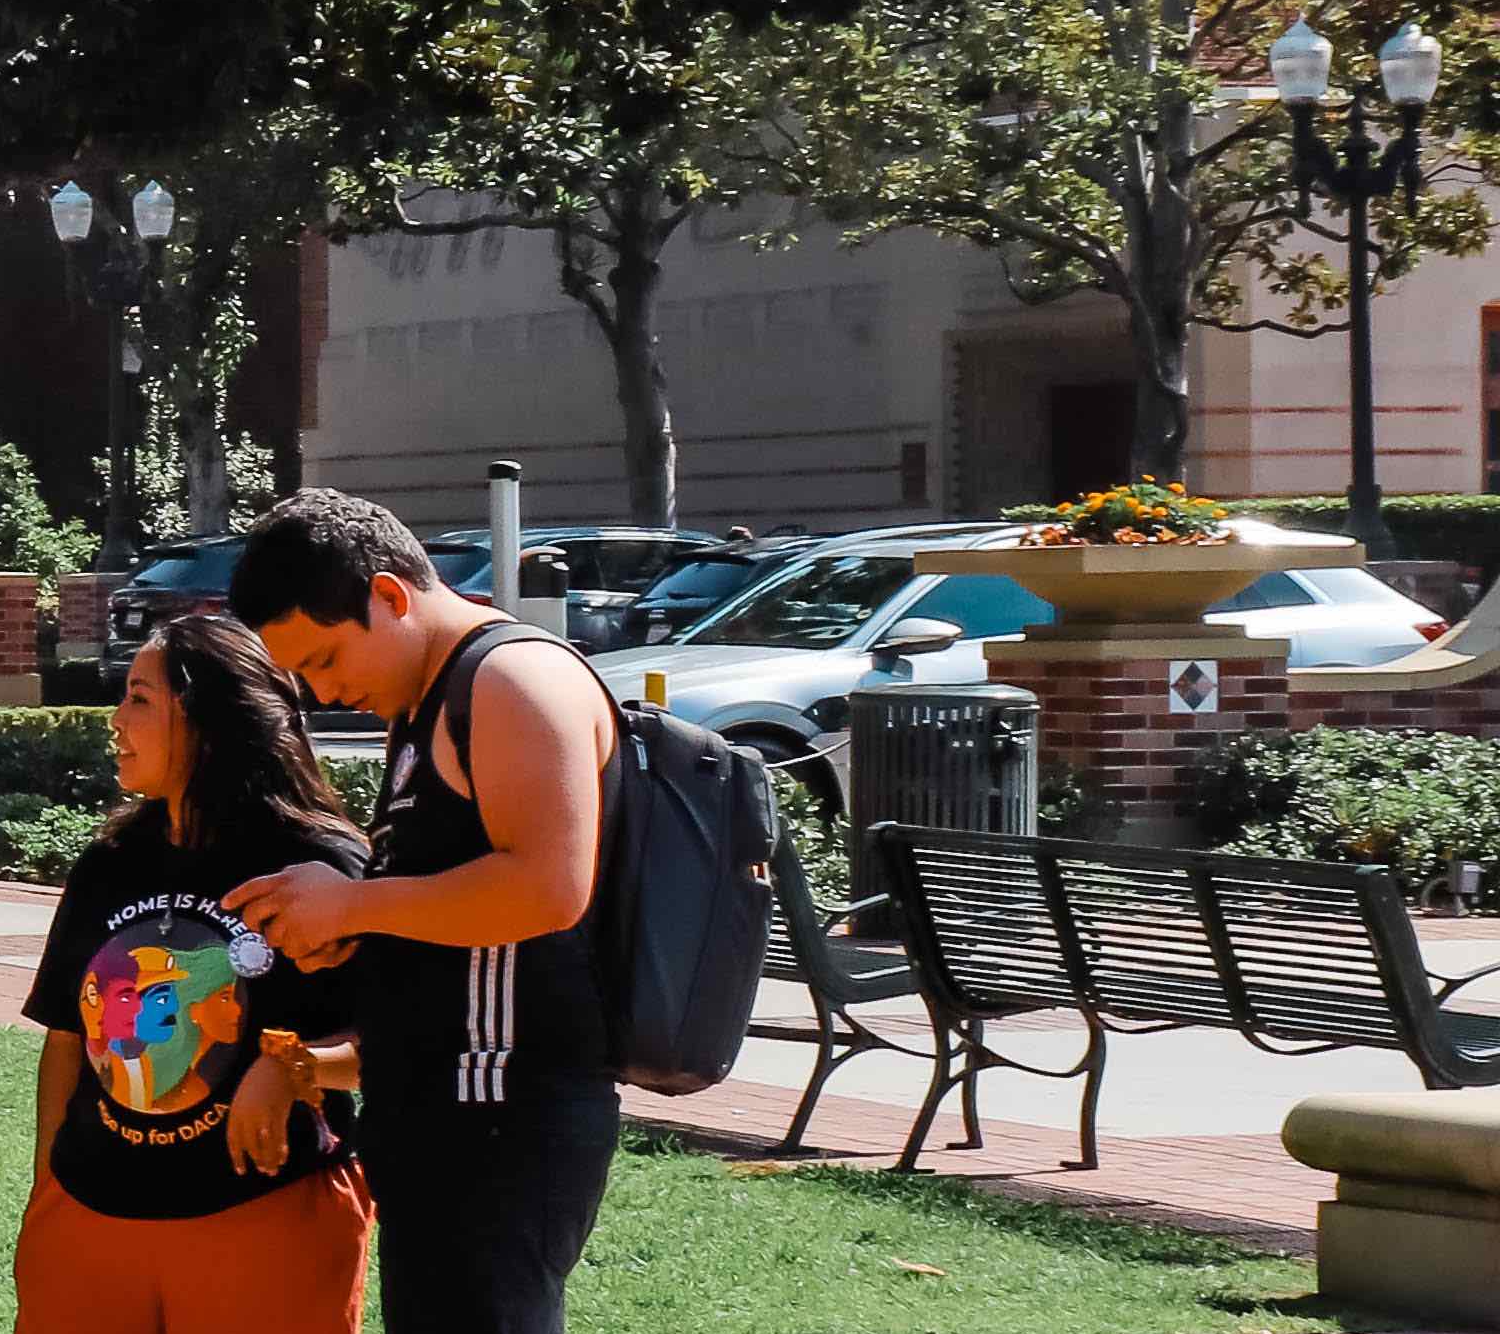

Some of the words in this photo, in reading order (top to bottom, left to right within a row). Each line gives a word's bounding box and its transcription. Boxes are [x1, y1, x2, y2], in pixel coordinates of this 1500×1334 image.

[106, 893, 171, 932] HOME
[174, 893, 196, 909] IS
[148, 1128, 175, 1145] for
[178, 1103, 229, 1140] DACA
